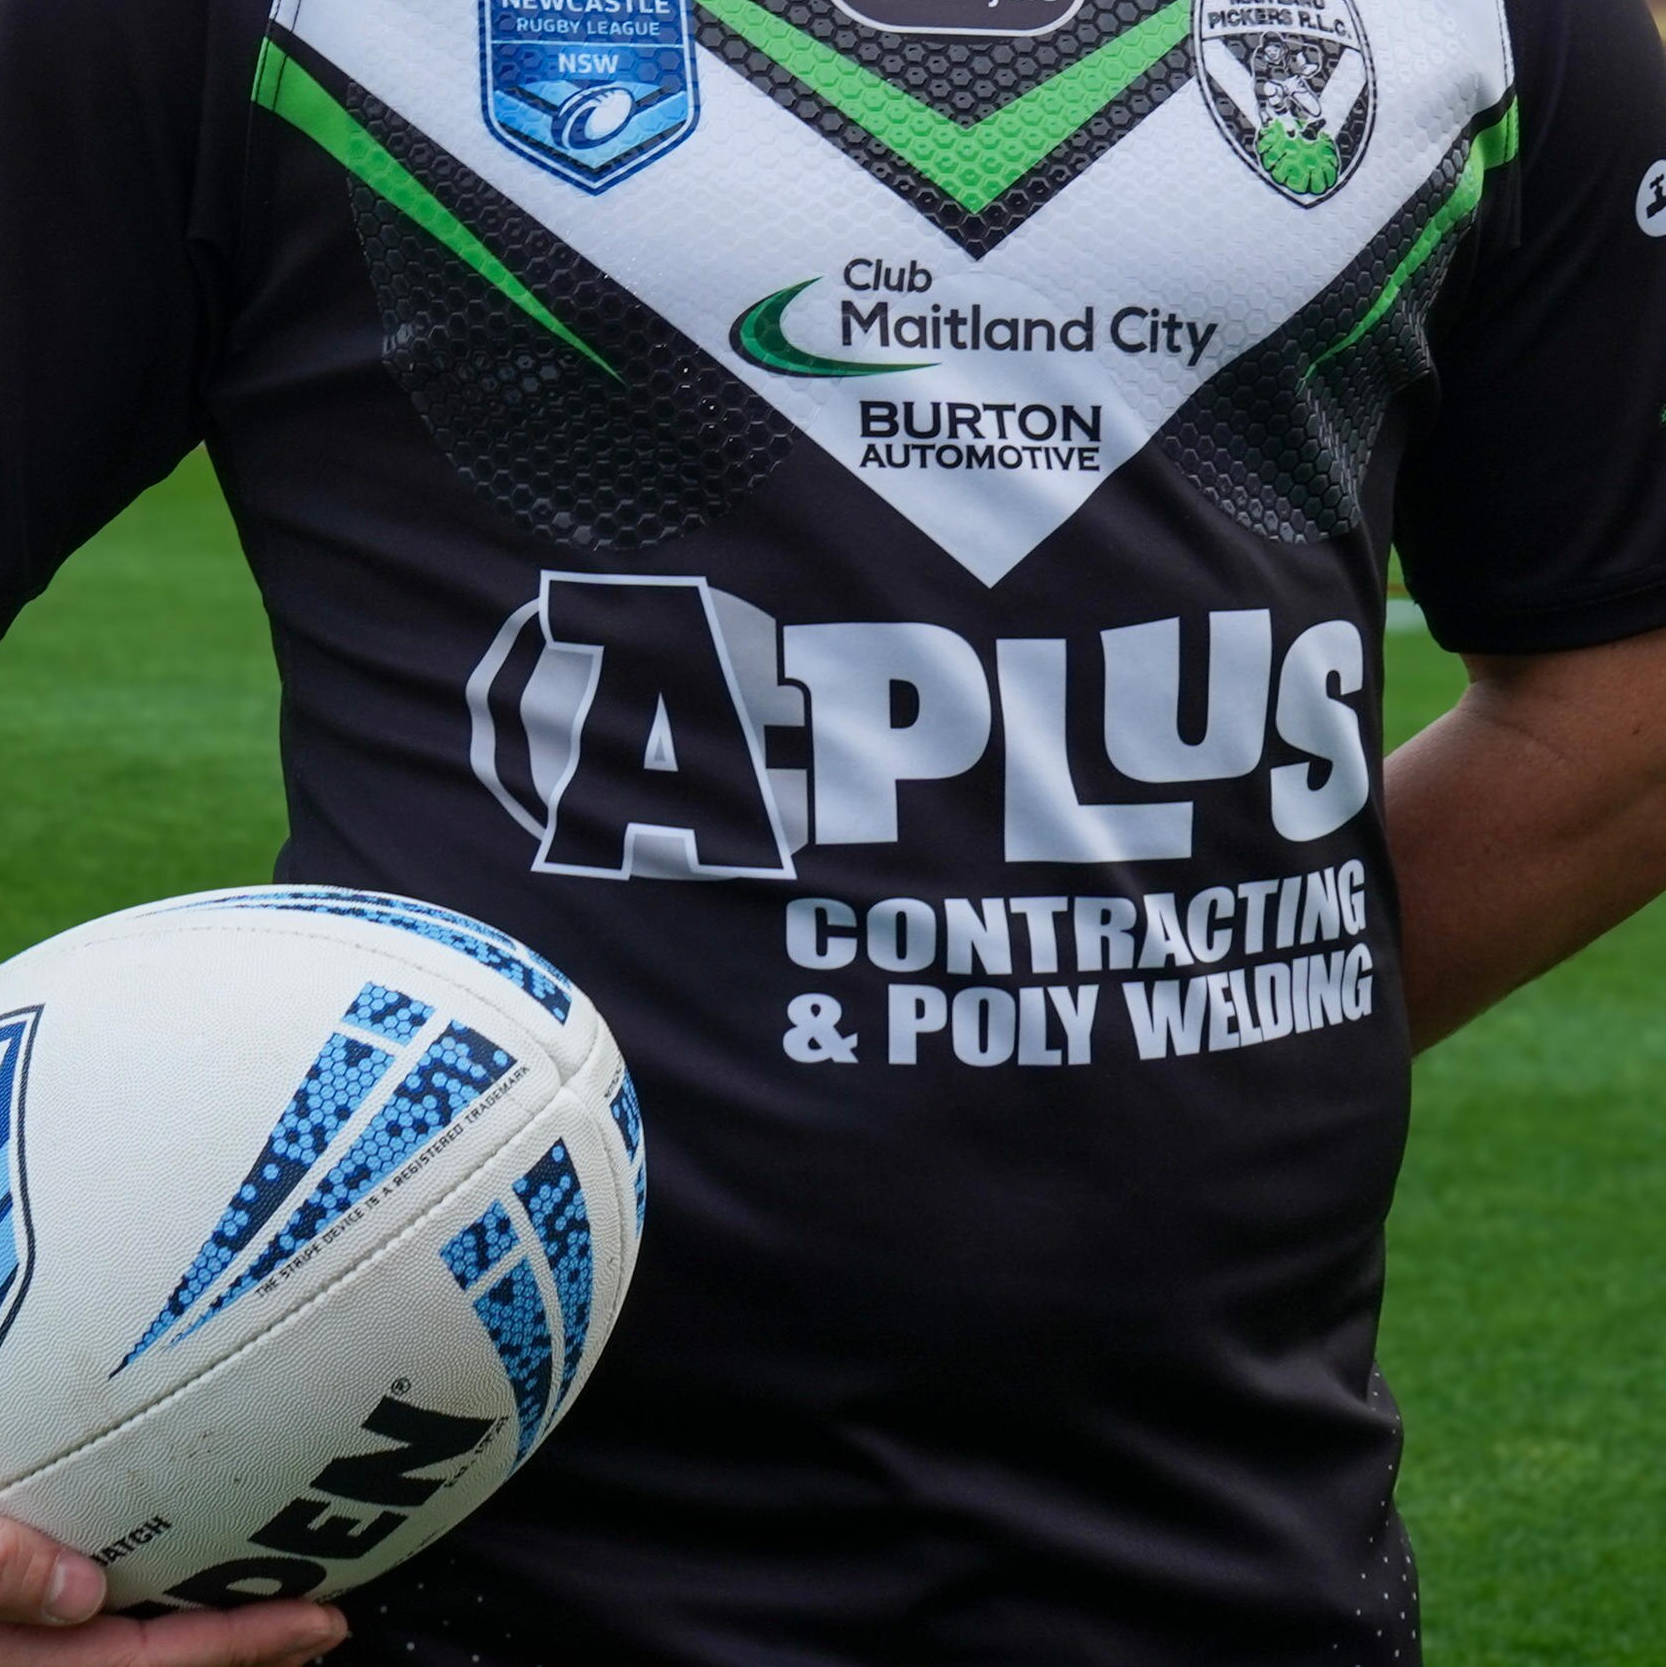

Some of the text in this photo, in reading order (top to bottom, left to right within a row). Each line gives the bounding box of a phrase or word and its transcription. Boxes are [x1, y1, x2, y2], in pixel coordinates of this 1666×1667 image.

[516, 17, 661, 36] RUGBY LEAGUE
[1207, 8, 1293, 30] PICKERS
[558, 52, 619, 74] NSW
[843, 258, 933, 293] Club
[841, 300, 1218, 367] Maitland City
[858, 399, 1102, 442] BURTON
[859, 443, 1101, 471] AUTOMOTIVE
[785, 859, 1366, 976] CONTRACTING
[782, 942, 1374, 1067] & POLY WELDING
[255, 1276, 279, 1298] THE
[279, 1244, 322, 1279] STRIPE
[324, 1209, 365, 1245] DEVICE
[393, 1125, 463, 1187] REGISTERED
[464, 1065, 530, 1123] TRADEMARK
[115, 1395, 496, 1619] DEN
